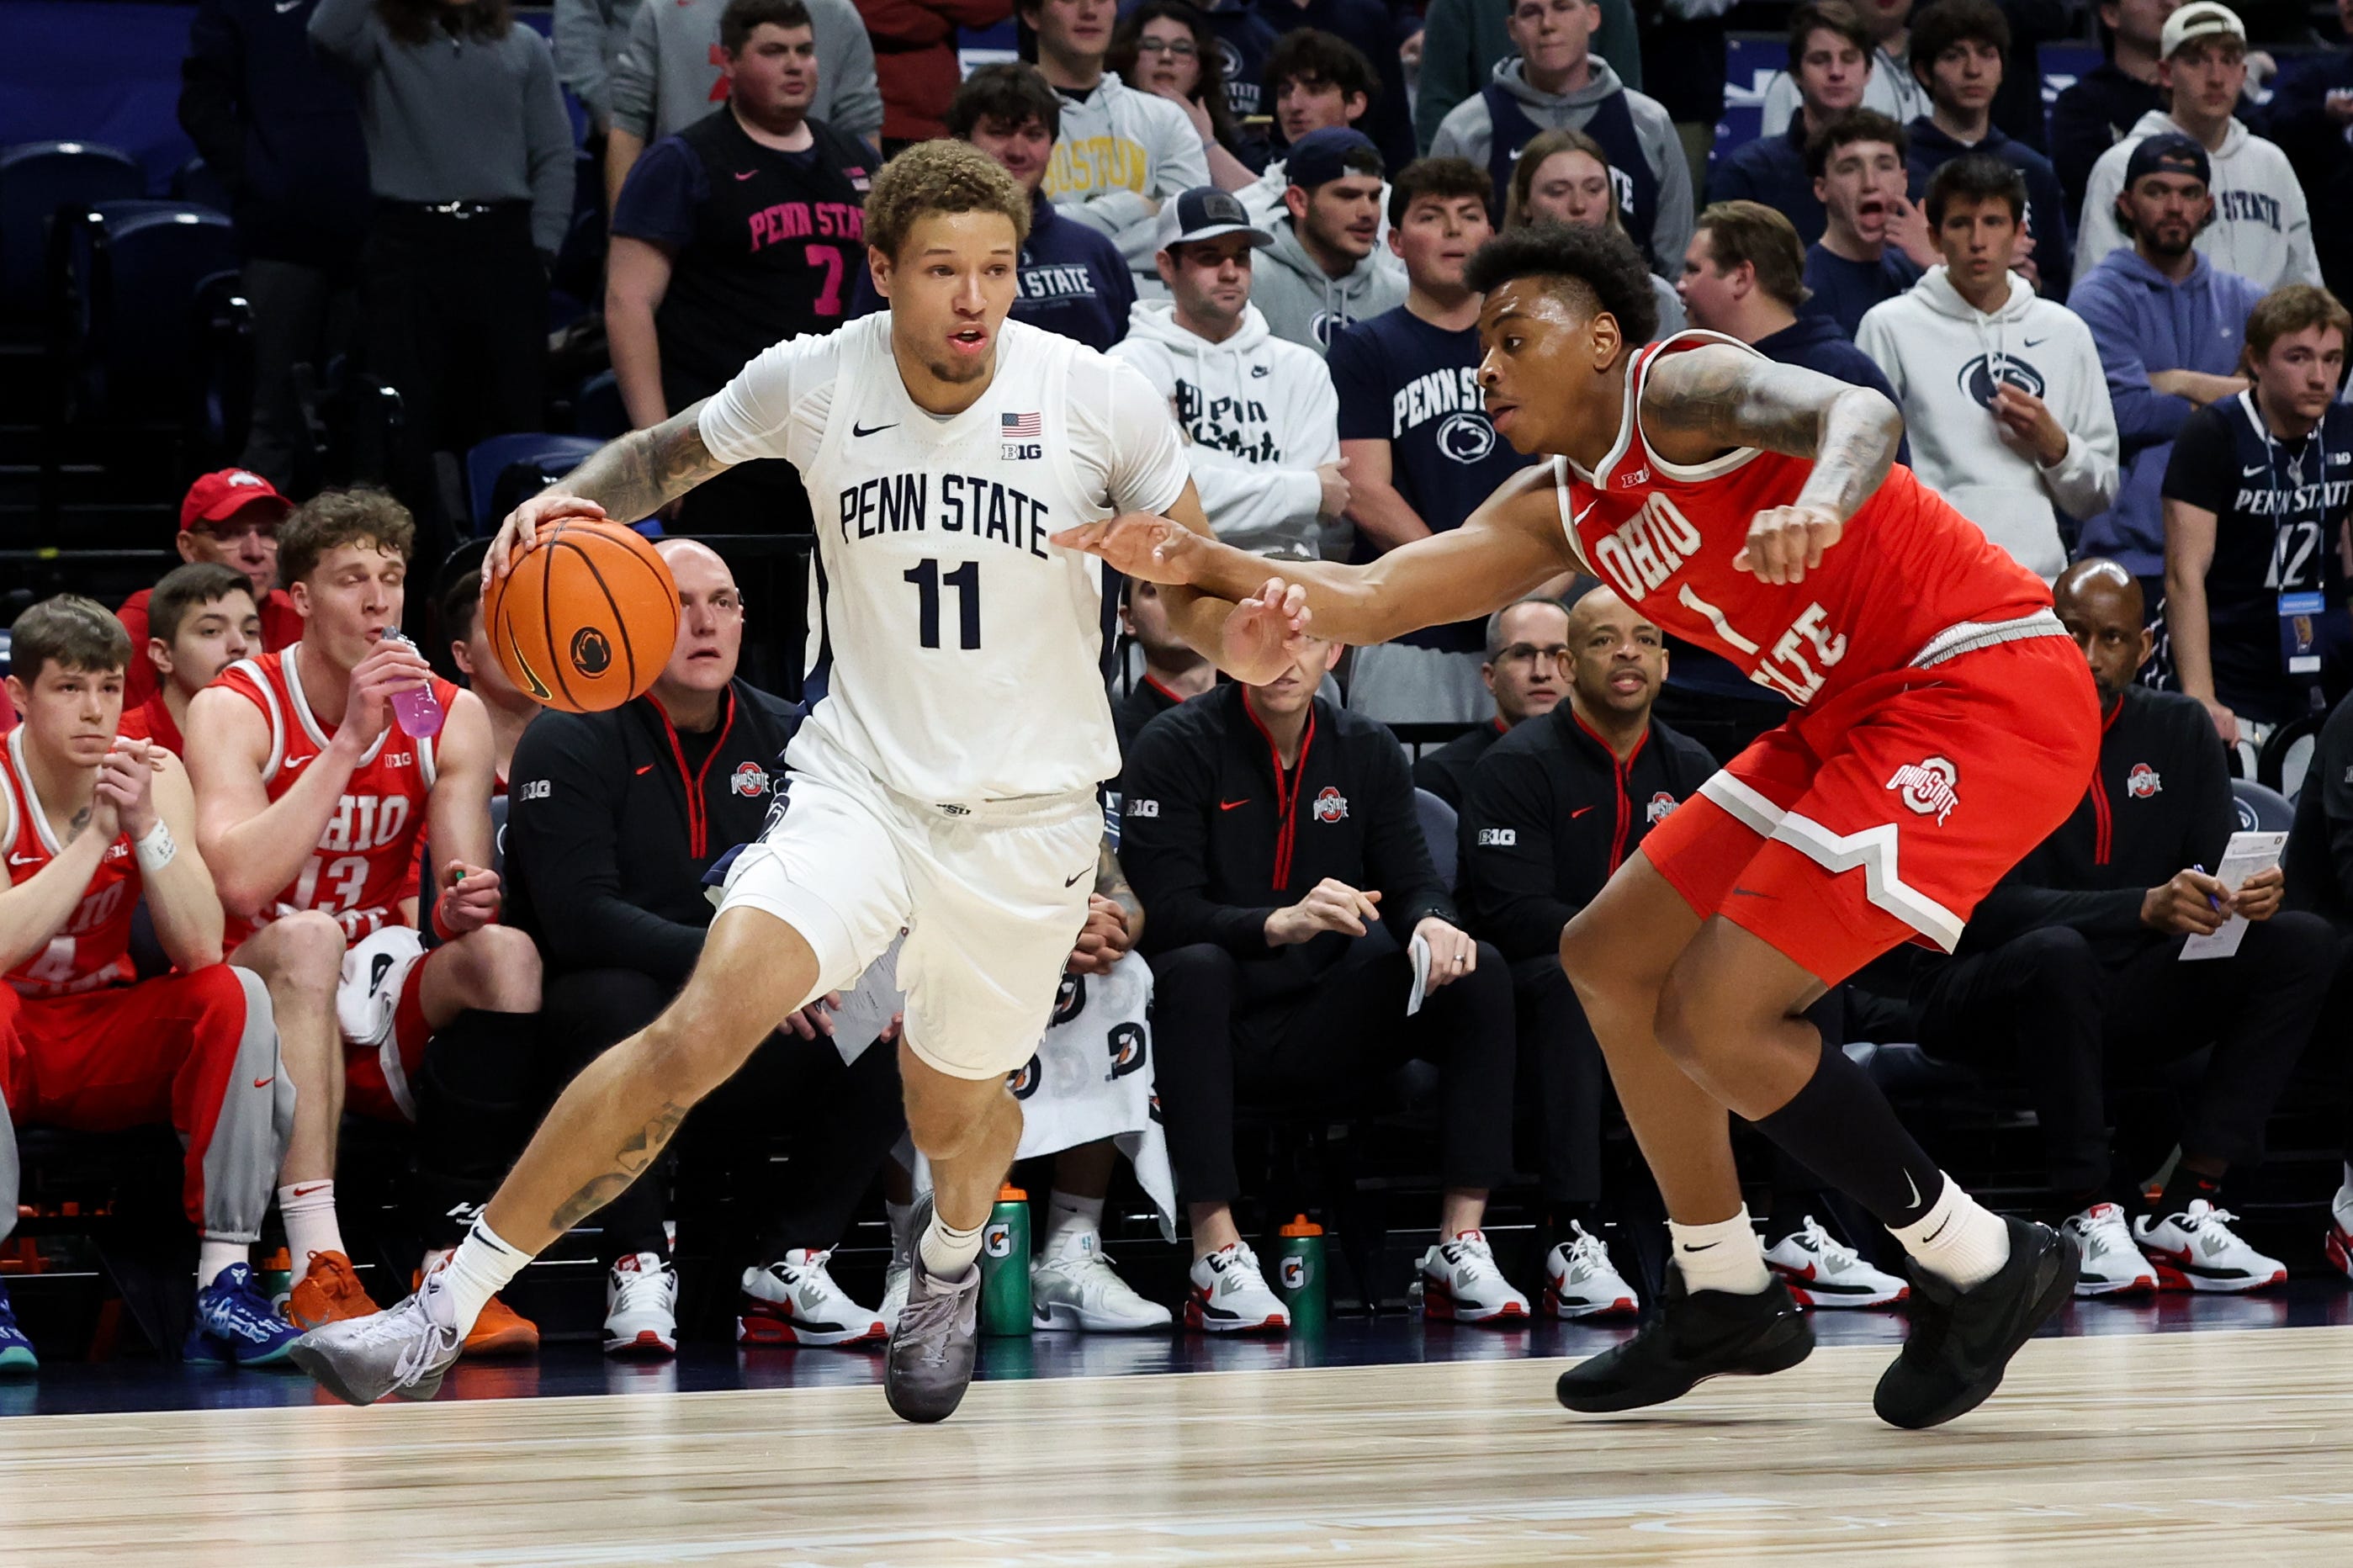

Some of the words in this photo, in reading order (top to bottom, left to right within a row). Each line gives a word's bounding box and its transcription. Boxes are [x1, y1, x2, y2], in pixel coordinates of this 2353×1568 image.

[749, 201, 813, 252] PENN
[804, 244, 844, 315] 7
[1024, 267, 1096, 299] STATE
[1392, 368, 1460, 439] PENN
[840, 473, 927, 544] PENN
[941, 474, 1049, 560] STATE
[2234, 488, 2293, 516] PENN
[1595, 490, 1703, 602] OHIO
[2263, 520, 2319, 589] 12
[903, 558, 982, 650] 11
[1677, 581, 1762, 656] 1
[317, 794, 410, 852] HIO
[1885, 764, 1931, 789] OHIO
[1917, 771, 1959, 828] STATE
[295, 855, 370, 914] 13
[27, 935, 77, 983] 4
[983, 1223, 1010, 1258] G
[1280, 1256, 1305, 1290] G
